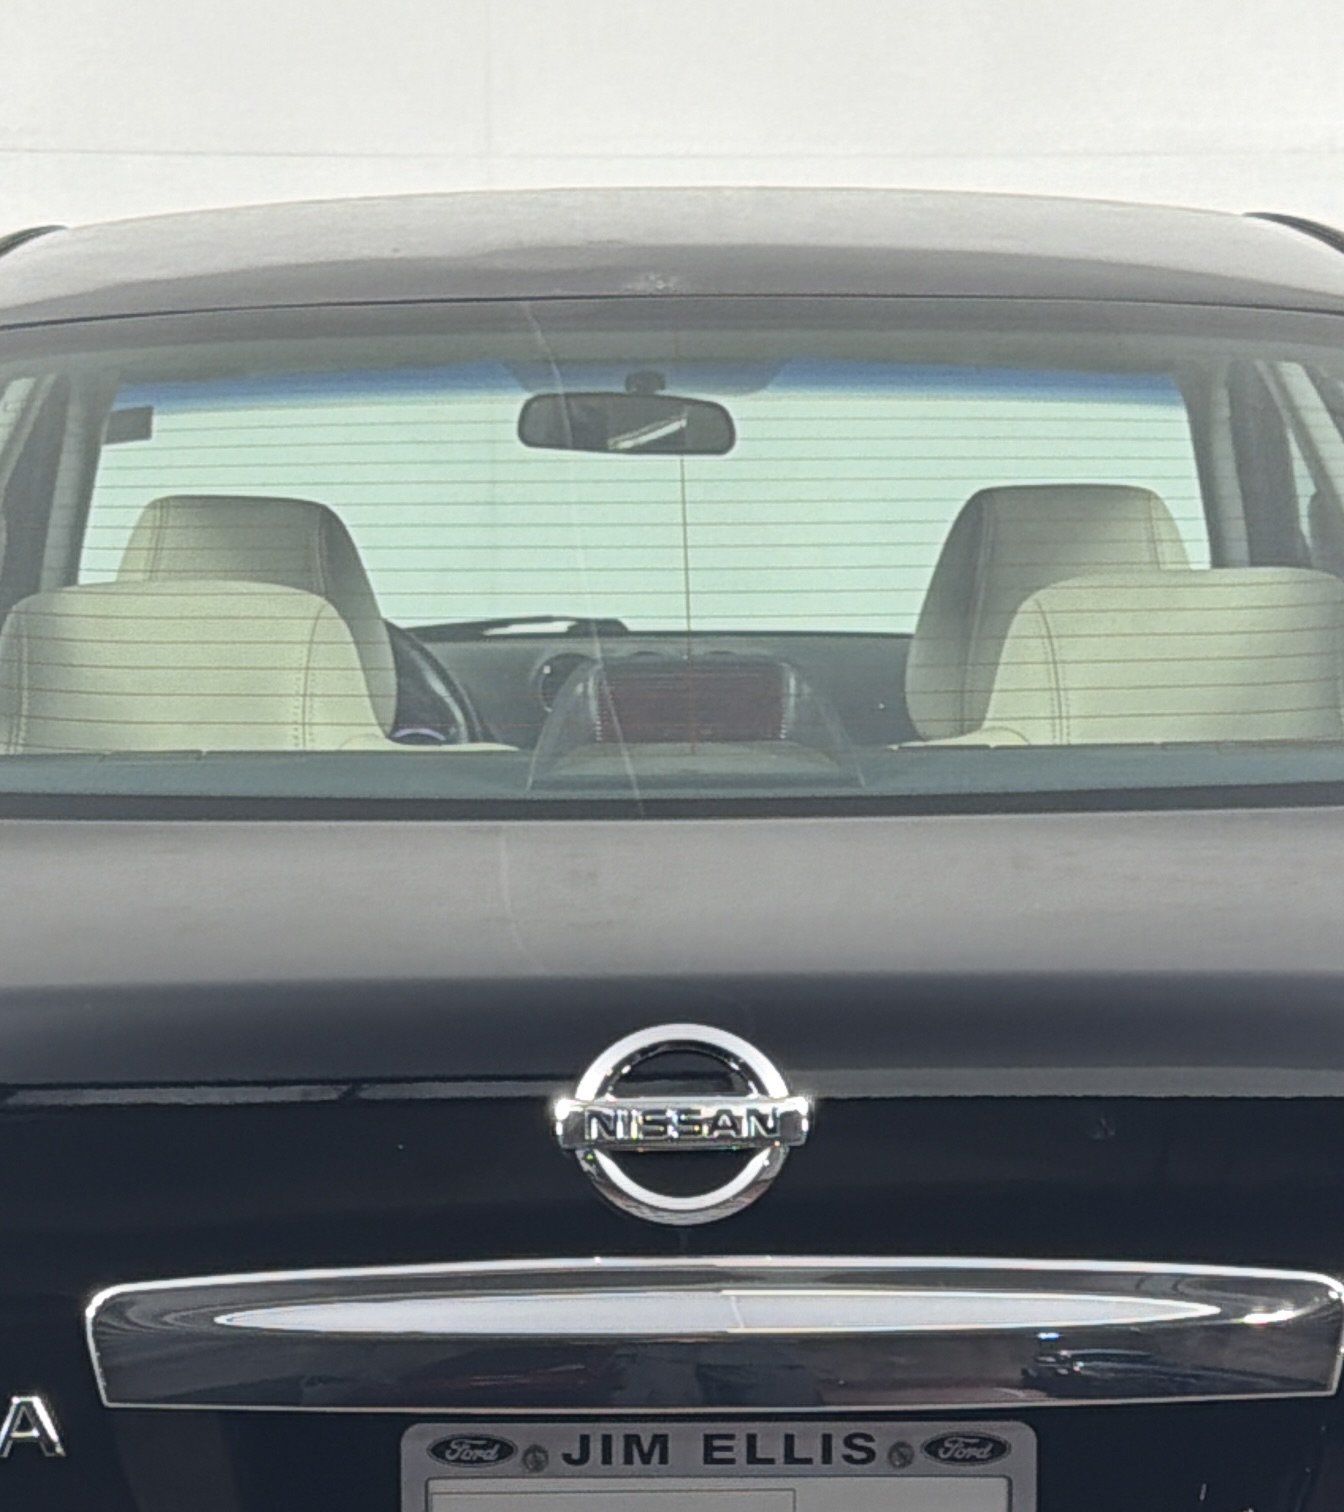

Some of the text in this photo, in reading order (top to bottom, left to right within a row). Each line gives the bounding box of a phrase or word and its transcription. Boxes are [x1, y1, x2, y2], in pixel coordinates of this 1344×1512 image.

[584, 1108, 781, 1140] NISSAN
[561, 1432, 877, 1466] JIM ELLIS
